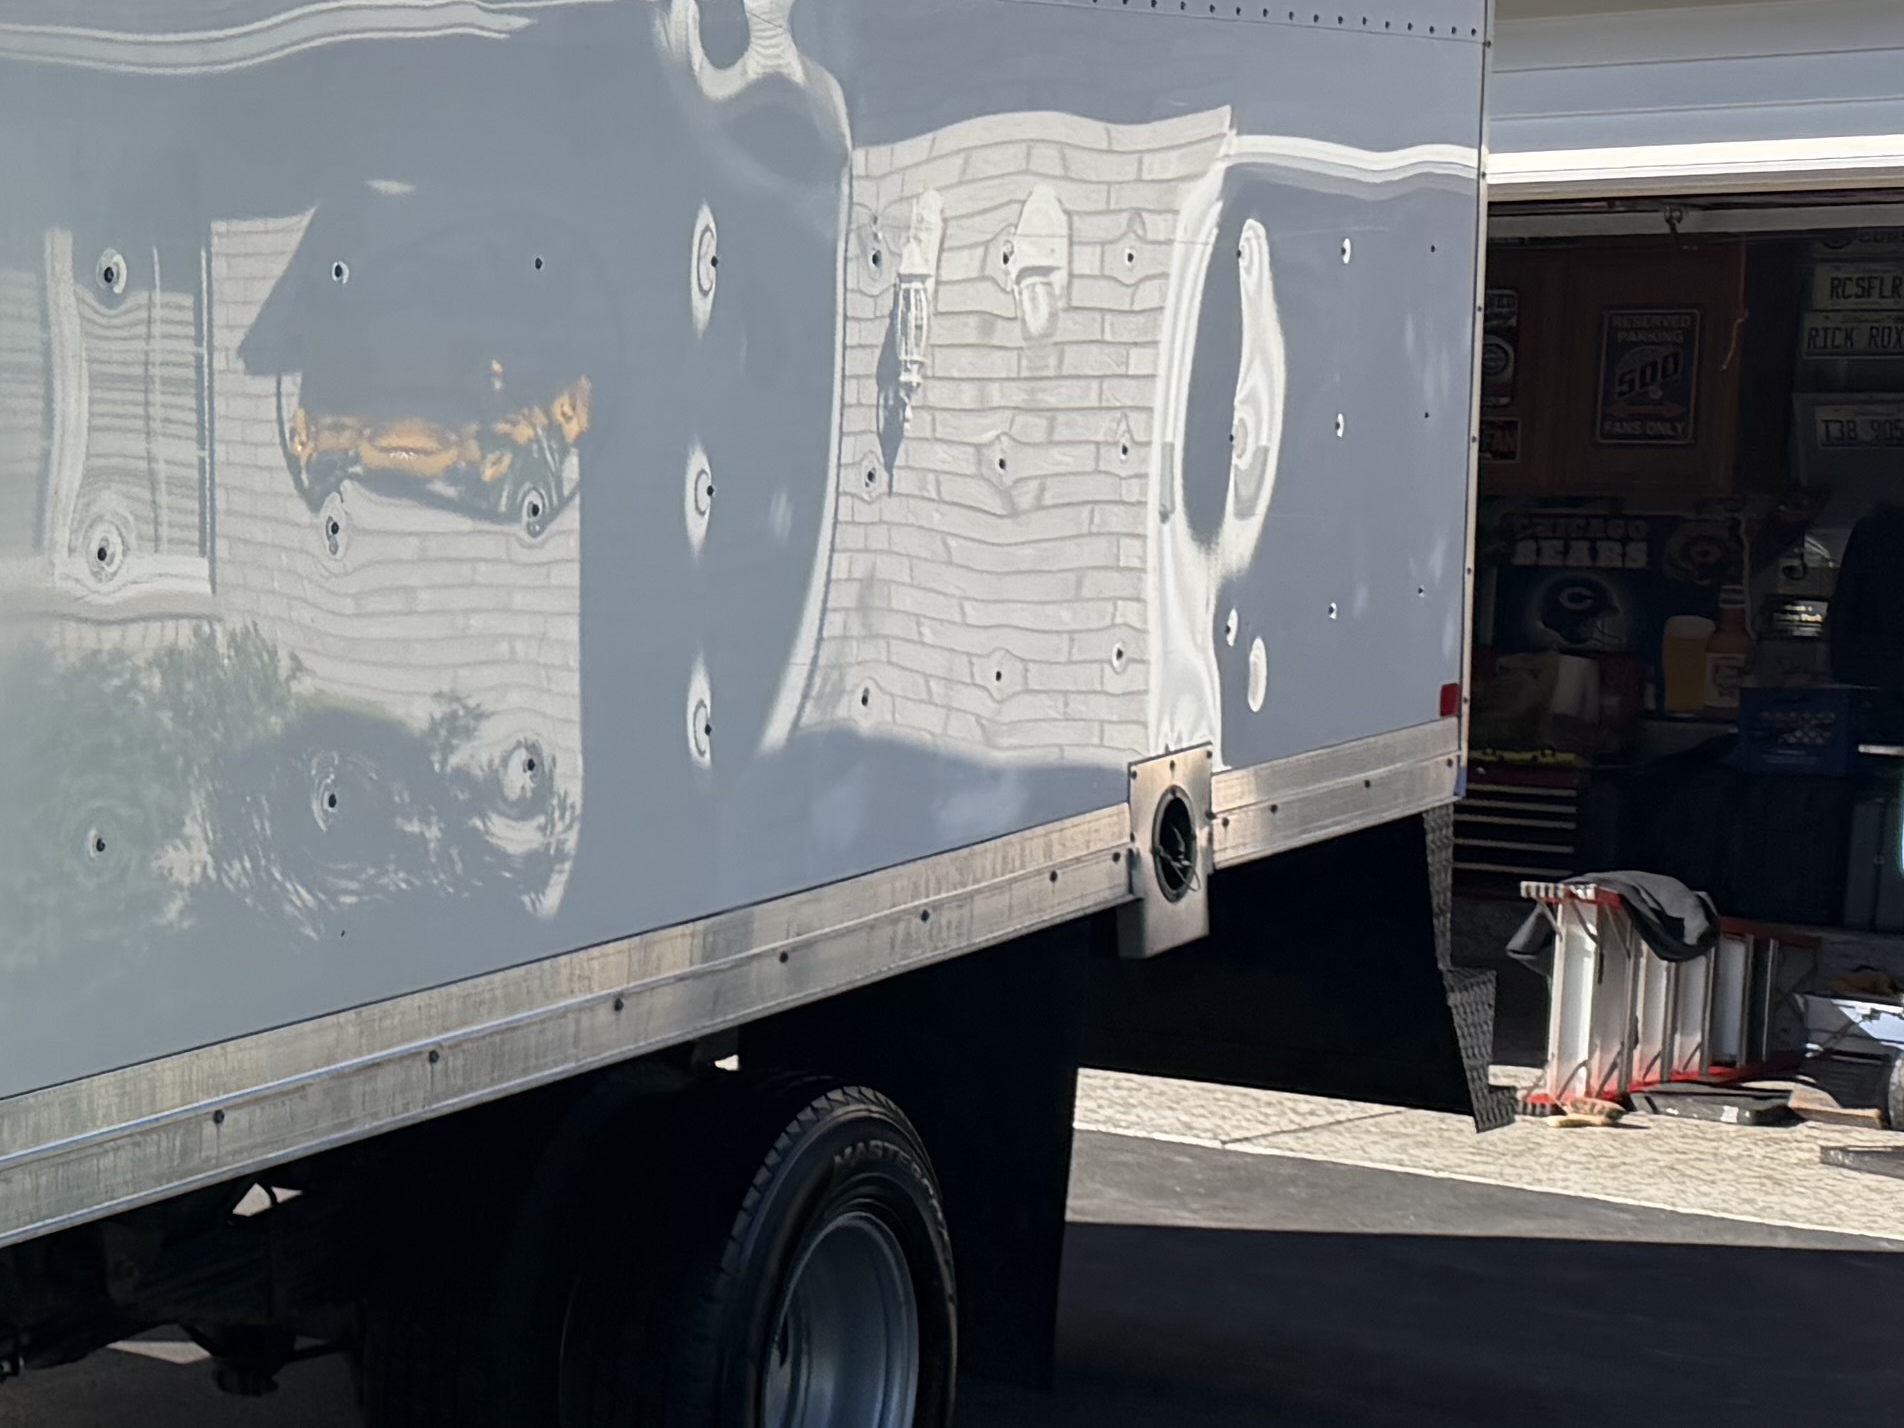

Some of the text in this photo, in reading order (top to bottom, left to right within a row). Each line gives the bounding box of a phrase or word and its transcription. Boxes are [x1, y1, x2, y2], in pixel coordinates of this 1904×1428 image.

[1617, 330, 1683, 343] PARKING
[1807, 326, 1854, 349] RICK
[1617, 352, 1680, 397] 500
[1603, 421, 1685, 436] FANS ONLY
[1511, 539, 1649, 568] BEARS
